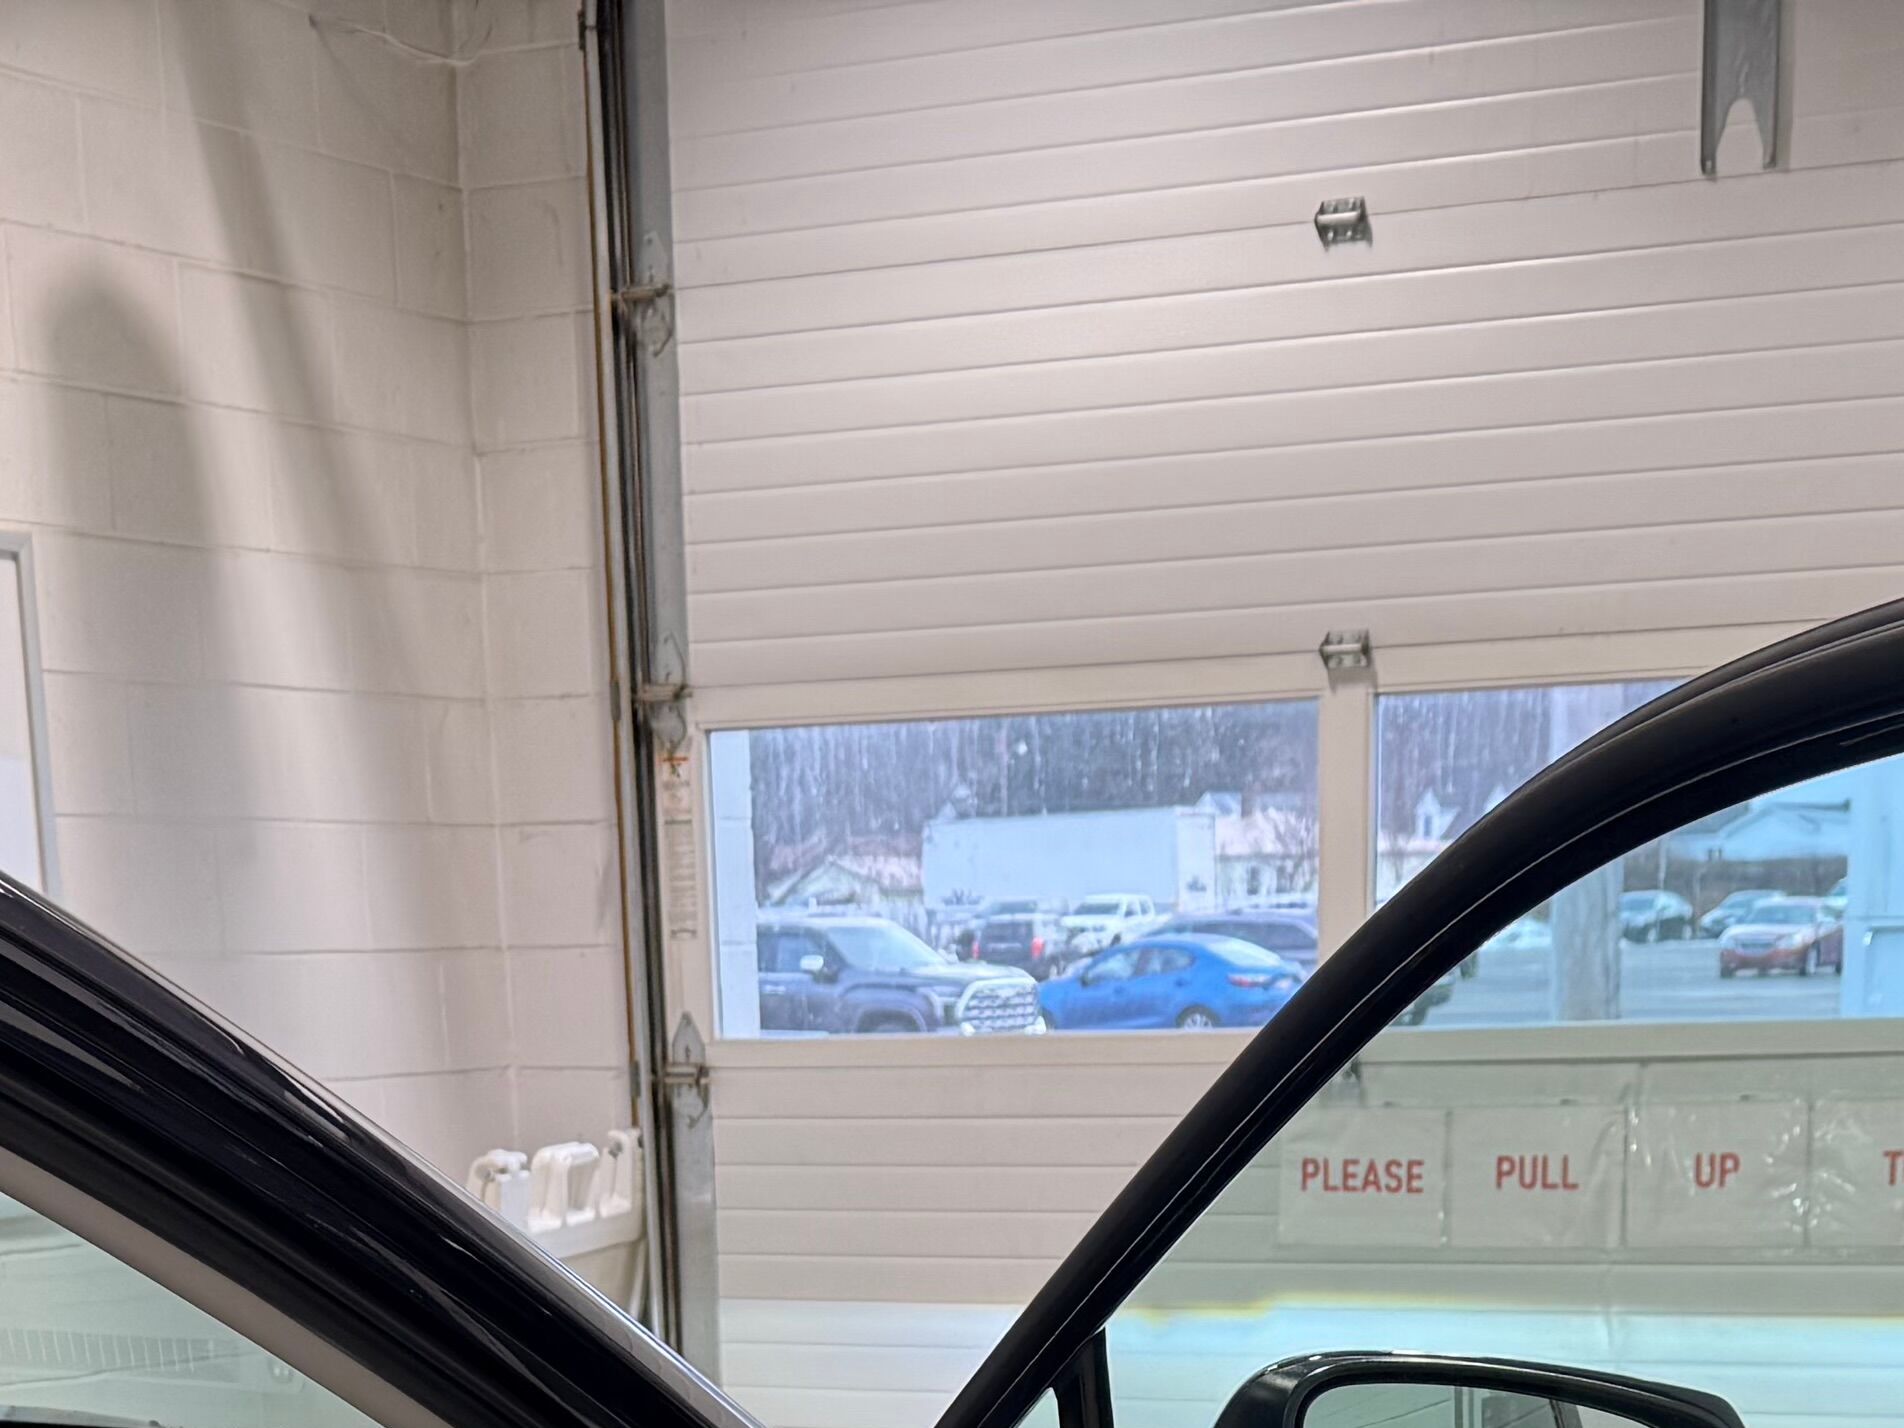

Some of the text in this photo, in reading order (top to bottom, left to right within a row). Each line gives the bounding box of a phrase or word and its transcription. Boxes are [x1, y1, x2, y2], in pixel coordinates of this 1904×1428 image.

[1300, 1157, 1424, 1194] PLEASE
[1495, 1155, 1579, 1191] PULL
[1694, 1152, 1741, 1189] UP
